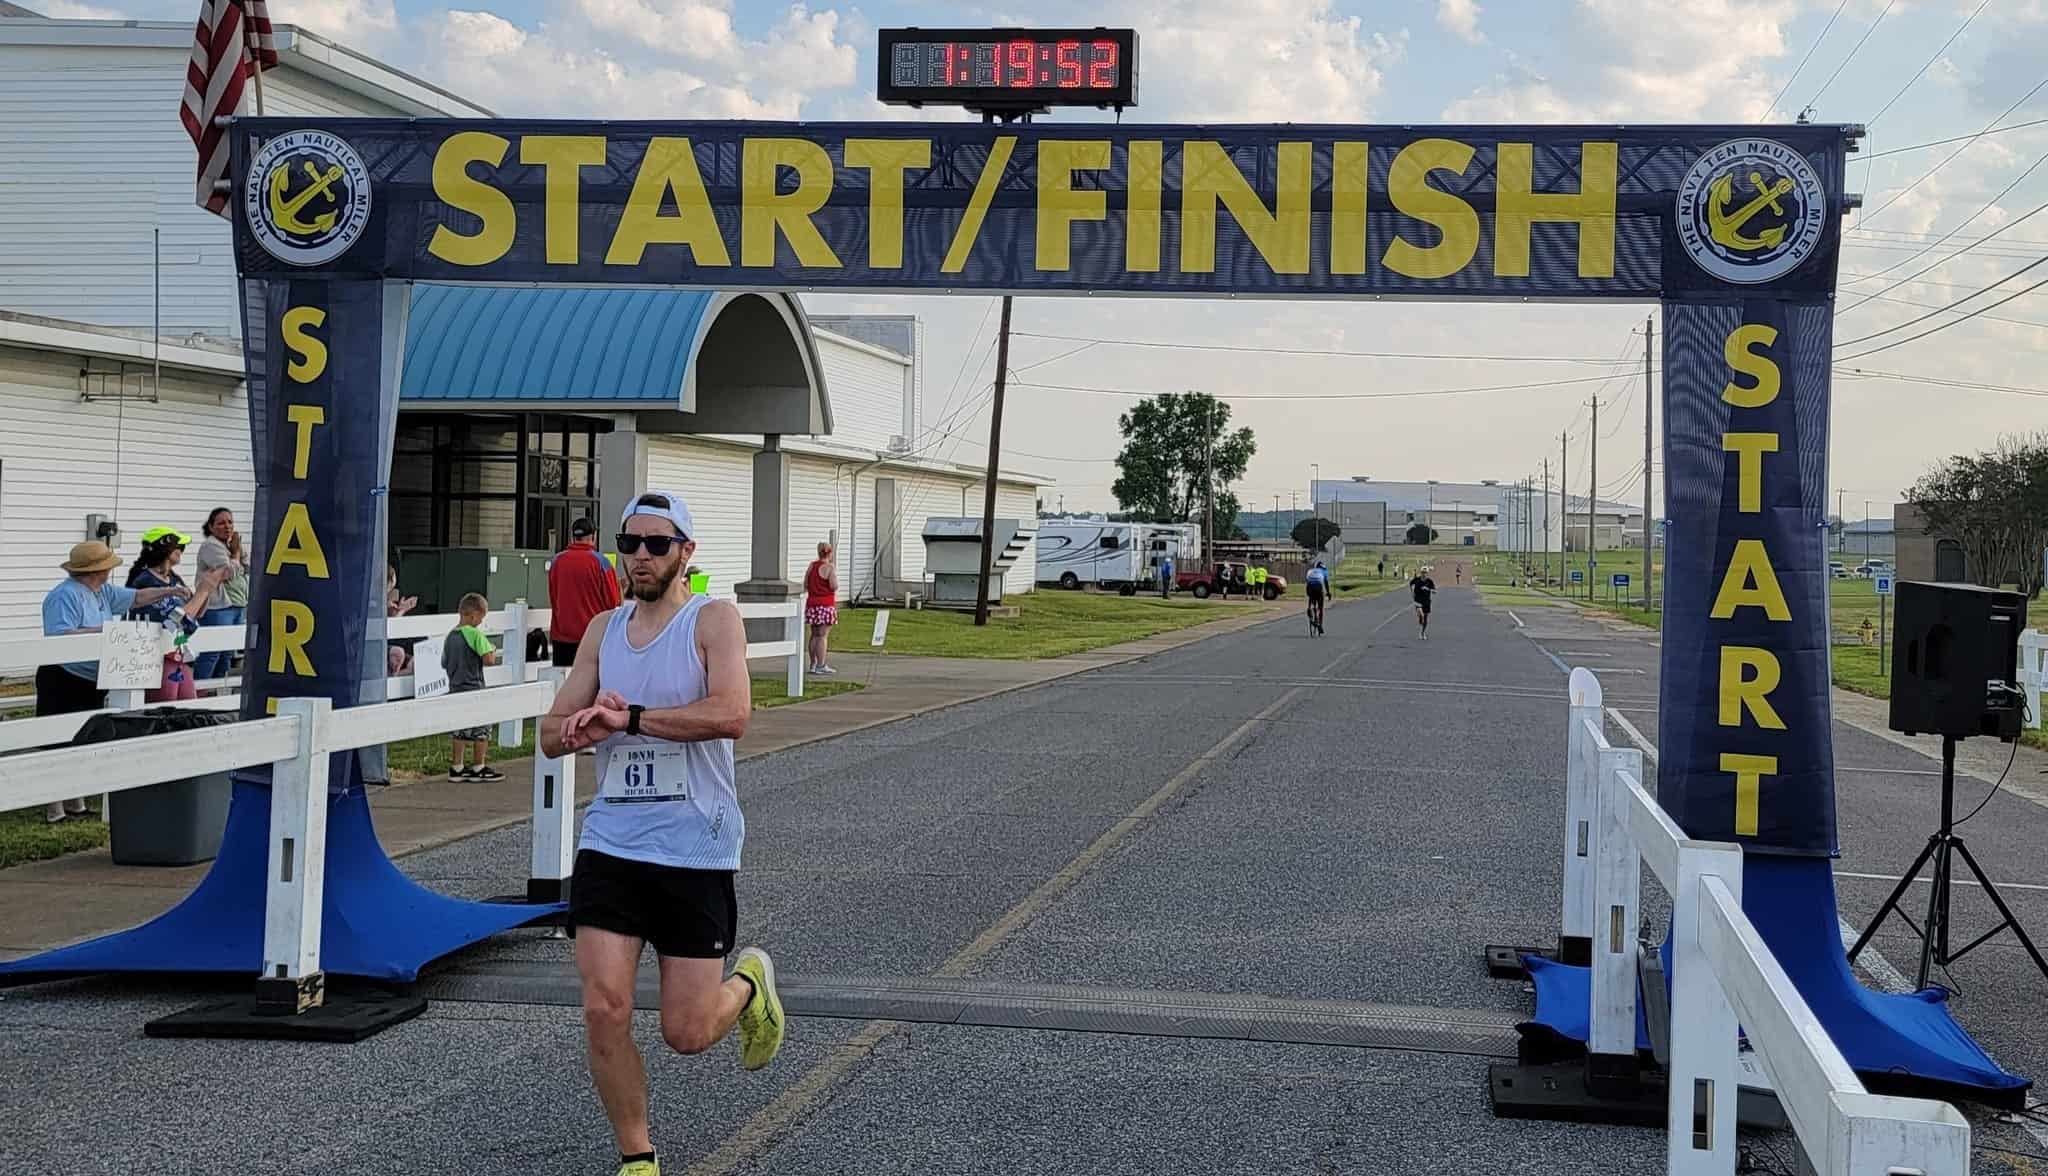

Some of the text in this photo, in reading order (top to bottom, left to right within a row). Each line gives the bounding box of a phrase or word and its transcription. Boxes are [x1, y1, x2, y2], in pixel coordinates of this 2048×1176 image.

[944, 40, 1118, 88] 1:19:52
[249, 134, 367, 243] THE NAVY TEN NAUTICAL MILER
[1681, 143, 1821, 260] THE NAVY TEN NAUTICAL MILER
[265, 306, 330, 715] STAR
[1710, 324, 1793, 837] START
[624, 763, 656, 788] 61
